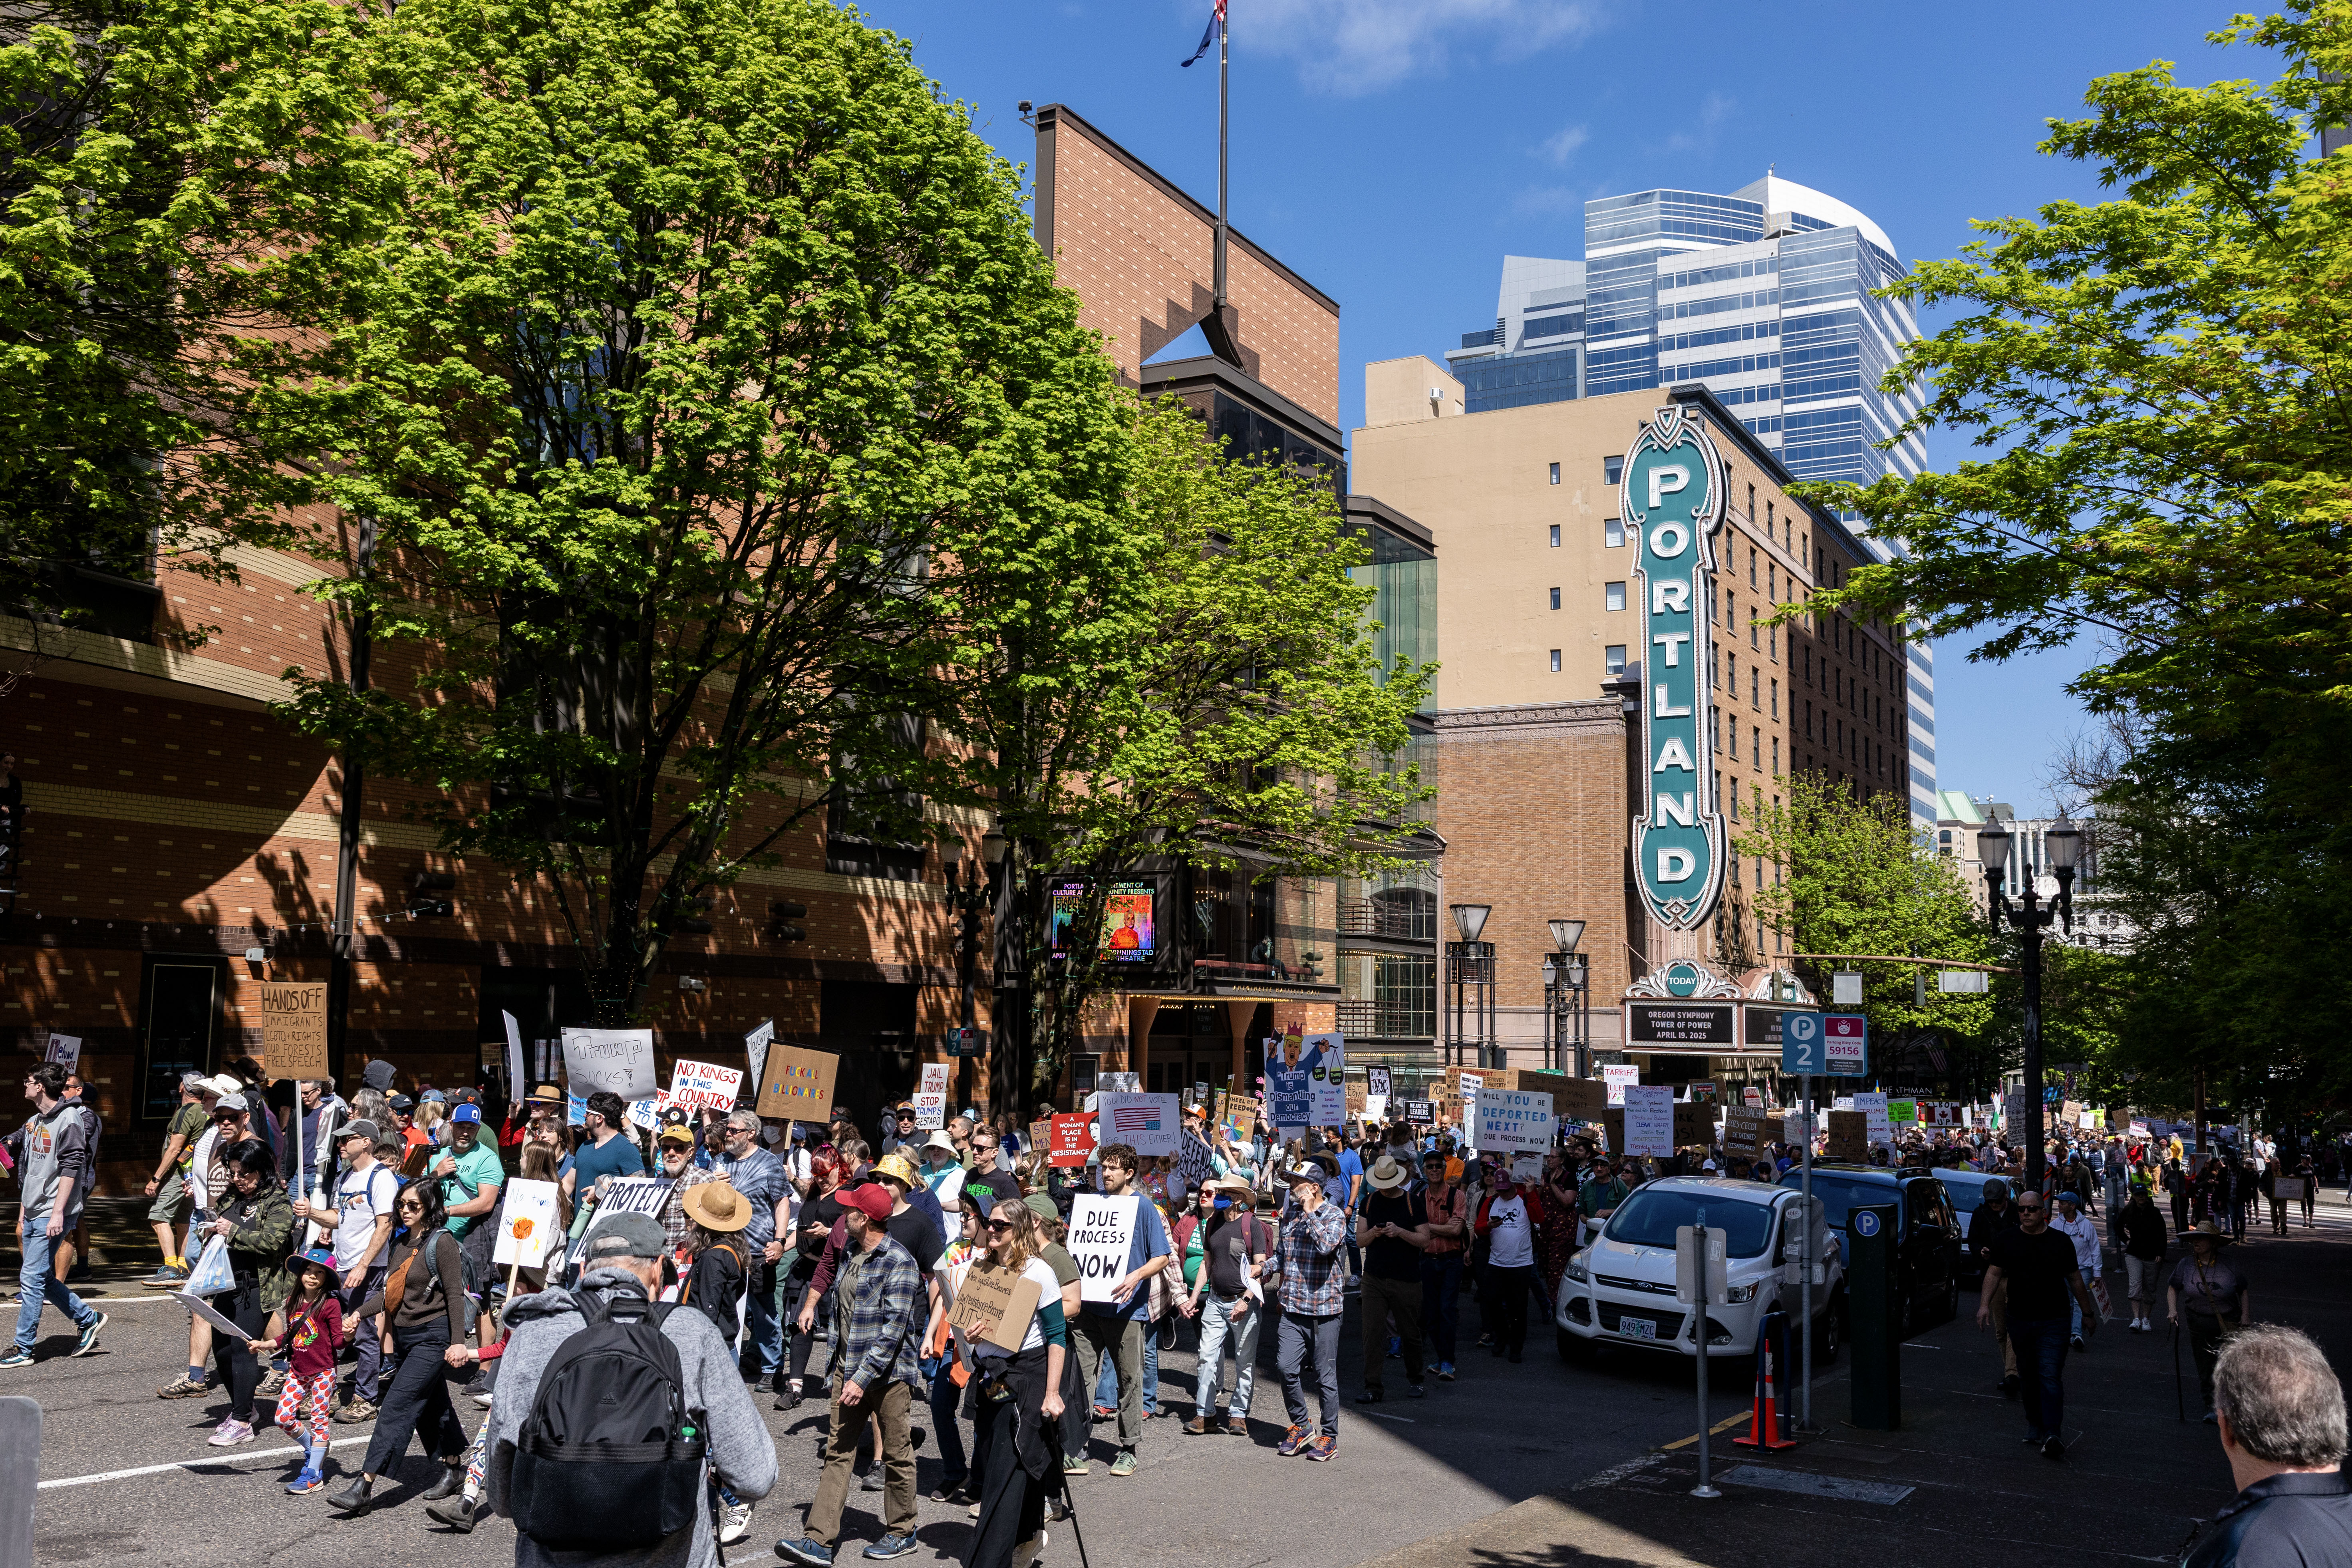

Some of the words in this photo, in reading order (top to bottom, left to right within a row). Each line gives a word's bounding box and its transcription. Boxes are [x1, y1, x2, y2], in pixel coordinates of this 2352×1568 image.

[1649, 466, 1695, 882] PORTLAND
[262, 988, 299, 1011] HANDS
[301, 988, 323, 1009] OFF
[265, 1015, 323, 1027] IMMIGRANTS
[1798, 1019, 1810, 1036] P
[266, 1031, 290, 1041] LGBTQ+
[292, 1031, 321, 1041] RIGHTS
[266, 1043, 280, 1053] OUR
[284, 1043, 322, 1056] FORESTS
[952, 1042, 956, 1052] 2
[1830, 1046, 1859, 1055] 59156
[1797, 1043, 1812, 1065] 2
[266, 1055, 286, 1068] FREE
[288, 1056, 321, 1067] SPEECH
[677, 1062, 695, 1076] NO
[699, 1066, 738, 1084] KINGS
[786, 1065, 806, 1077] FUCK
[807, 1069, 818, 1079] ALL
[927, 1067, 943, 1079] JAIL
[679, 1077, 688, 1086] IN
[692, 1079, 712, 1089] THIS
[924, 1081, 944, 1093] TRUMP
[1525, 1074, 1584, 1089] IMMIGRANTS
[773, 1083, 824, 1099] BILLIONAIRES
[1270, 1090, 1315, 1102] Dismantling
[678, 1088, 735, 1111] COUNTRY
[920, 1096, 939, 1106] STOP
[1102, 1095, 1117, 1106] YOU
[1507, 1095, 1529, 1105] YOU
[1566, 1100, 1587, 1109] GREAT!
[1647, 1100, 1663, 1109] Systems
[916, 1107, 942, 1116] TRUMP'S
[1230, 1103, 1256, 1113] REEDOM
[1482, 1107, 1547, 1122] DEPORTED
[1728, 1106, 1767, 1119] 1933-DACHAU
[916, 1117, 941, 1126] GESTAPO
[1845, 1113, 1866, 1121] EVIL
[1486, 1121, 1524, 1132] NEXT?
[1106, 1137, 1118, 1146] FOR
[1124, 1134, 1146, 1145] THIS
[1149, 1132, 1176, 1144] EITHER!
[1732, 1132, 1756, 1140] DETAINED
[1182, 1132, 1211, 1169] DEFEND
[1728, 1142, 1755, 1151] DISAPPEARED
[461, 1165, 471, 1174] UP!
[967, 1184, 993, 1196] GREEN
[598, 1182, 671, 1212] PROTECT
[1087, 1211, 1119, 1226] DUE
[1863, 1216, 1873, 1233] P
[1074, 1230, 1125, 1243] PROCESS
[1073, 1253, 1122, 1278] NOW
[967, 1269, 977, 1284] When
[976, 1275, 995, 1291] injustice
[994, 1278, 1011, 1296] Becomes
[965, 1293, 988, 1313] resistance
[987, 1300, 1005, 1321] Becomes
[952, 1302, 983, 1328] DUTY
[1622, 1321, 1635, 1332] 949
[1640, 1324, 1654, 1335] MZC
